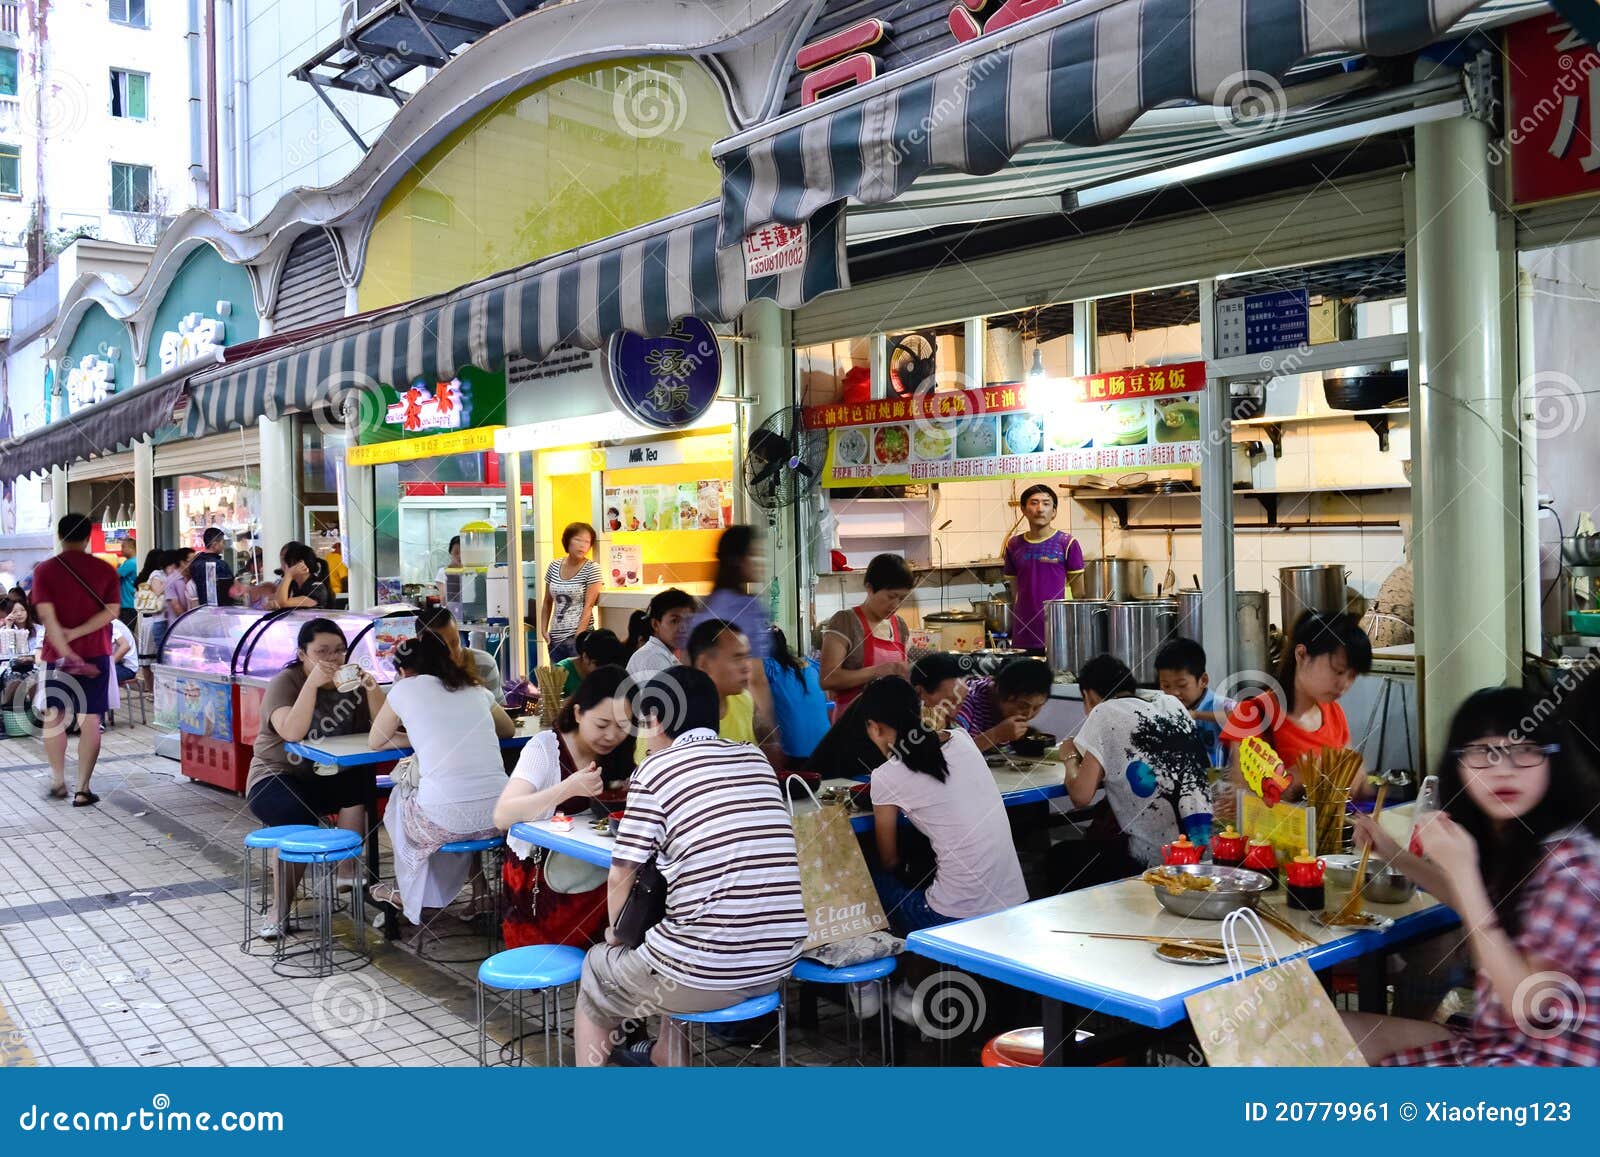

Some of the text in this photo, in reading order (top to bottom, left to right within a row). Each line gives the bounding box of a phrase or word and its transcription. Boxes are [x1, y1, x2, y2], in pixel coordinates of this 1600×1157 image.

[629, 447, 658, 463] Milk Tea
[815, 902, 867, 927] Etam
[807, 914, 883, 943] WEEKEND
